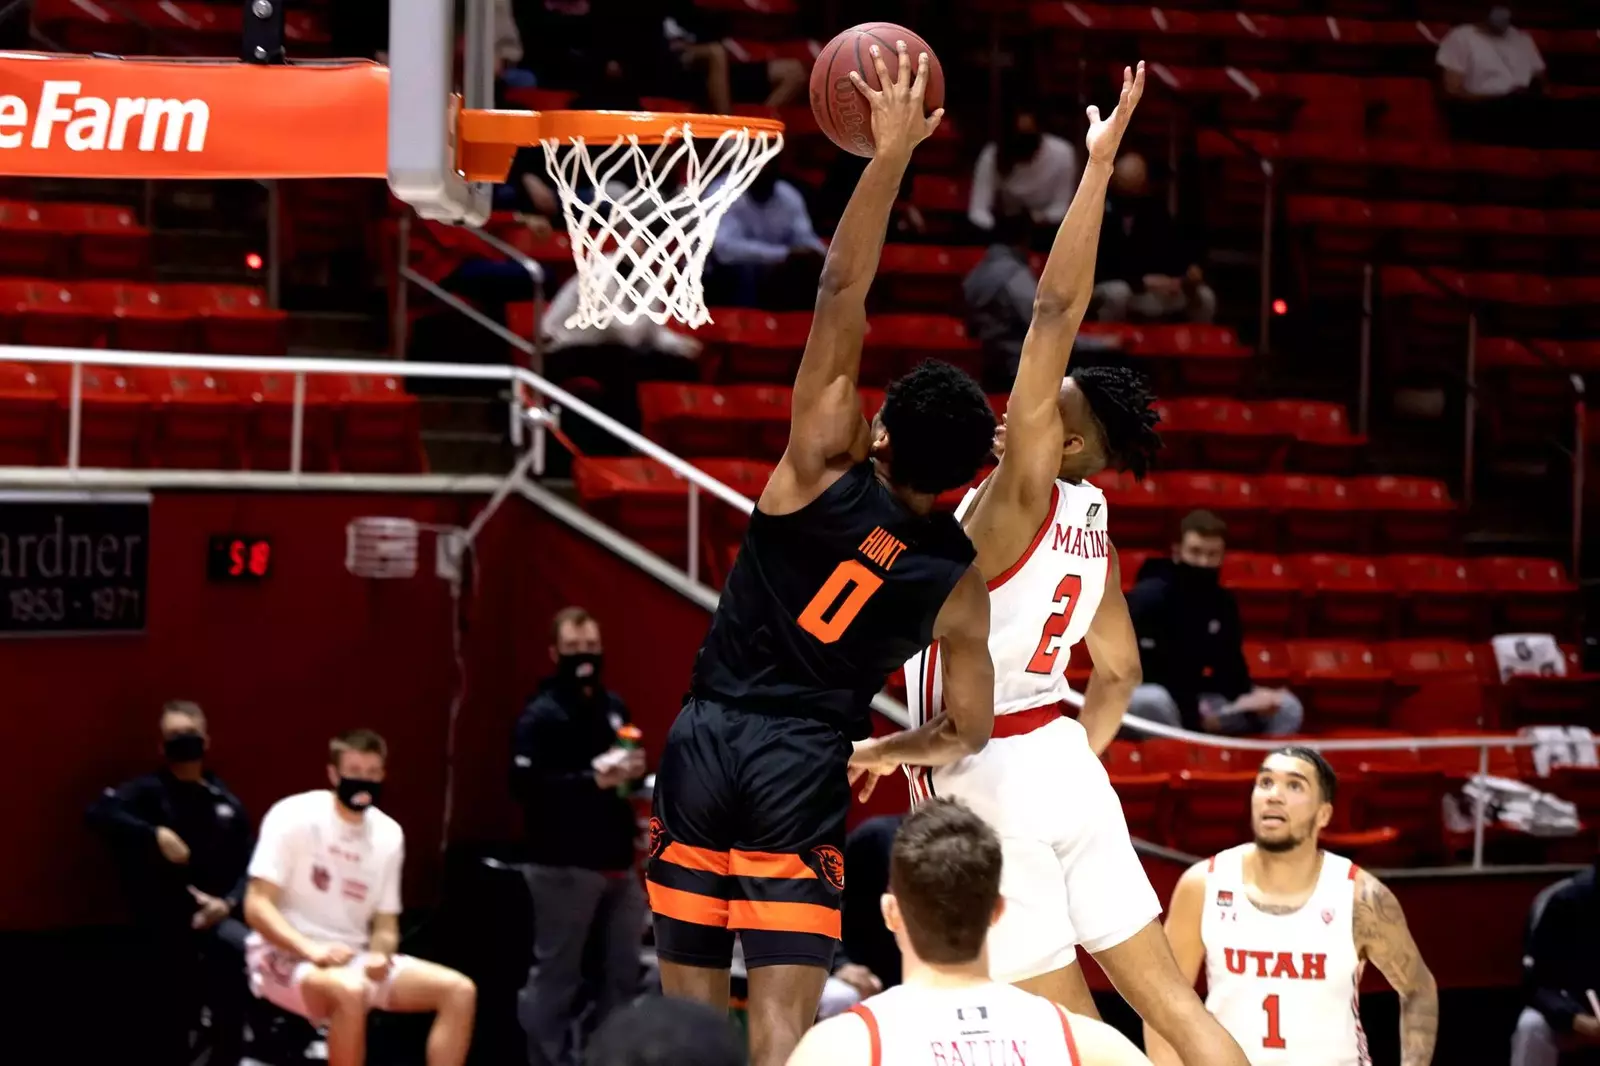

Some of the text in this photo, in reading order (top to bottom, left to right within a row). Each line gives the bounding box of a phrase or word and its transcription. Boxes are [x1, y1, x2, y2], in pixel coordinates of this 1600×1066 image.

[858, 526, 907, 571] HUNT
[797, 559, 884, 644] 0
[1025, 574, 1082, 675] 2
[1224, 947, 1327, 980] UTAH
[1262, 993, 1286, 1049] 1
